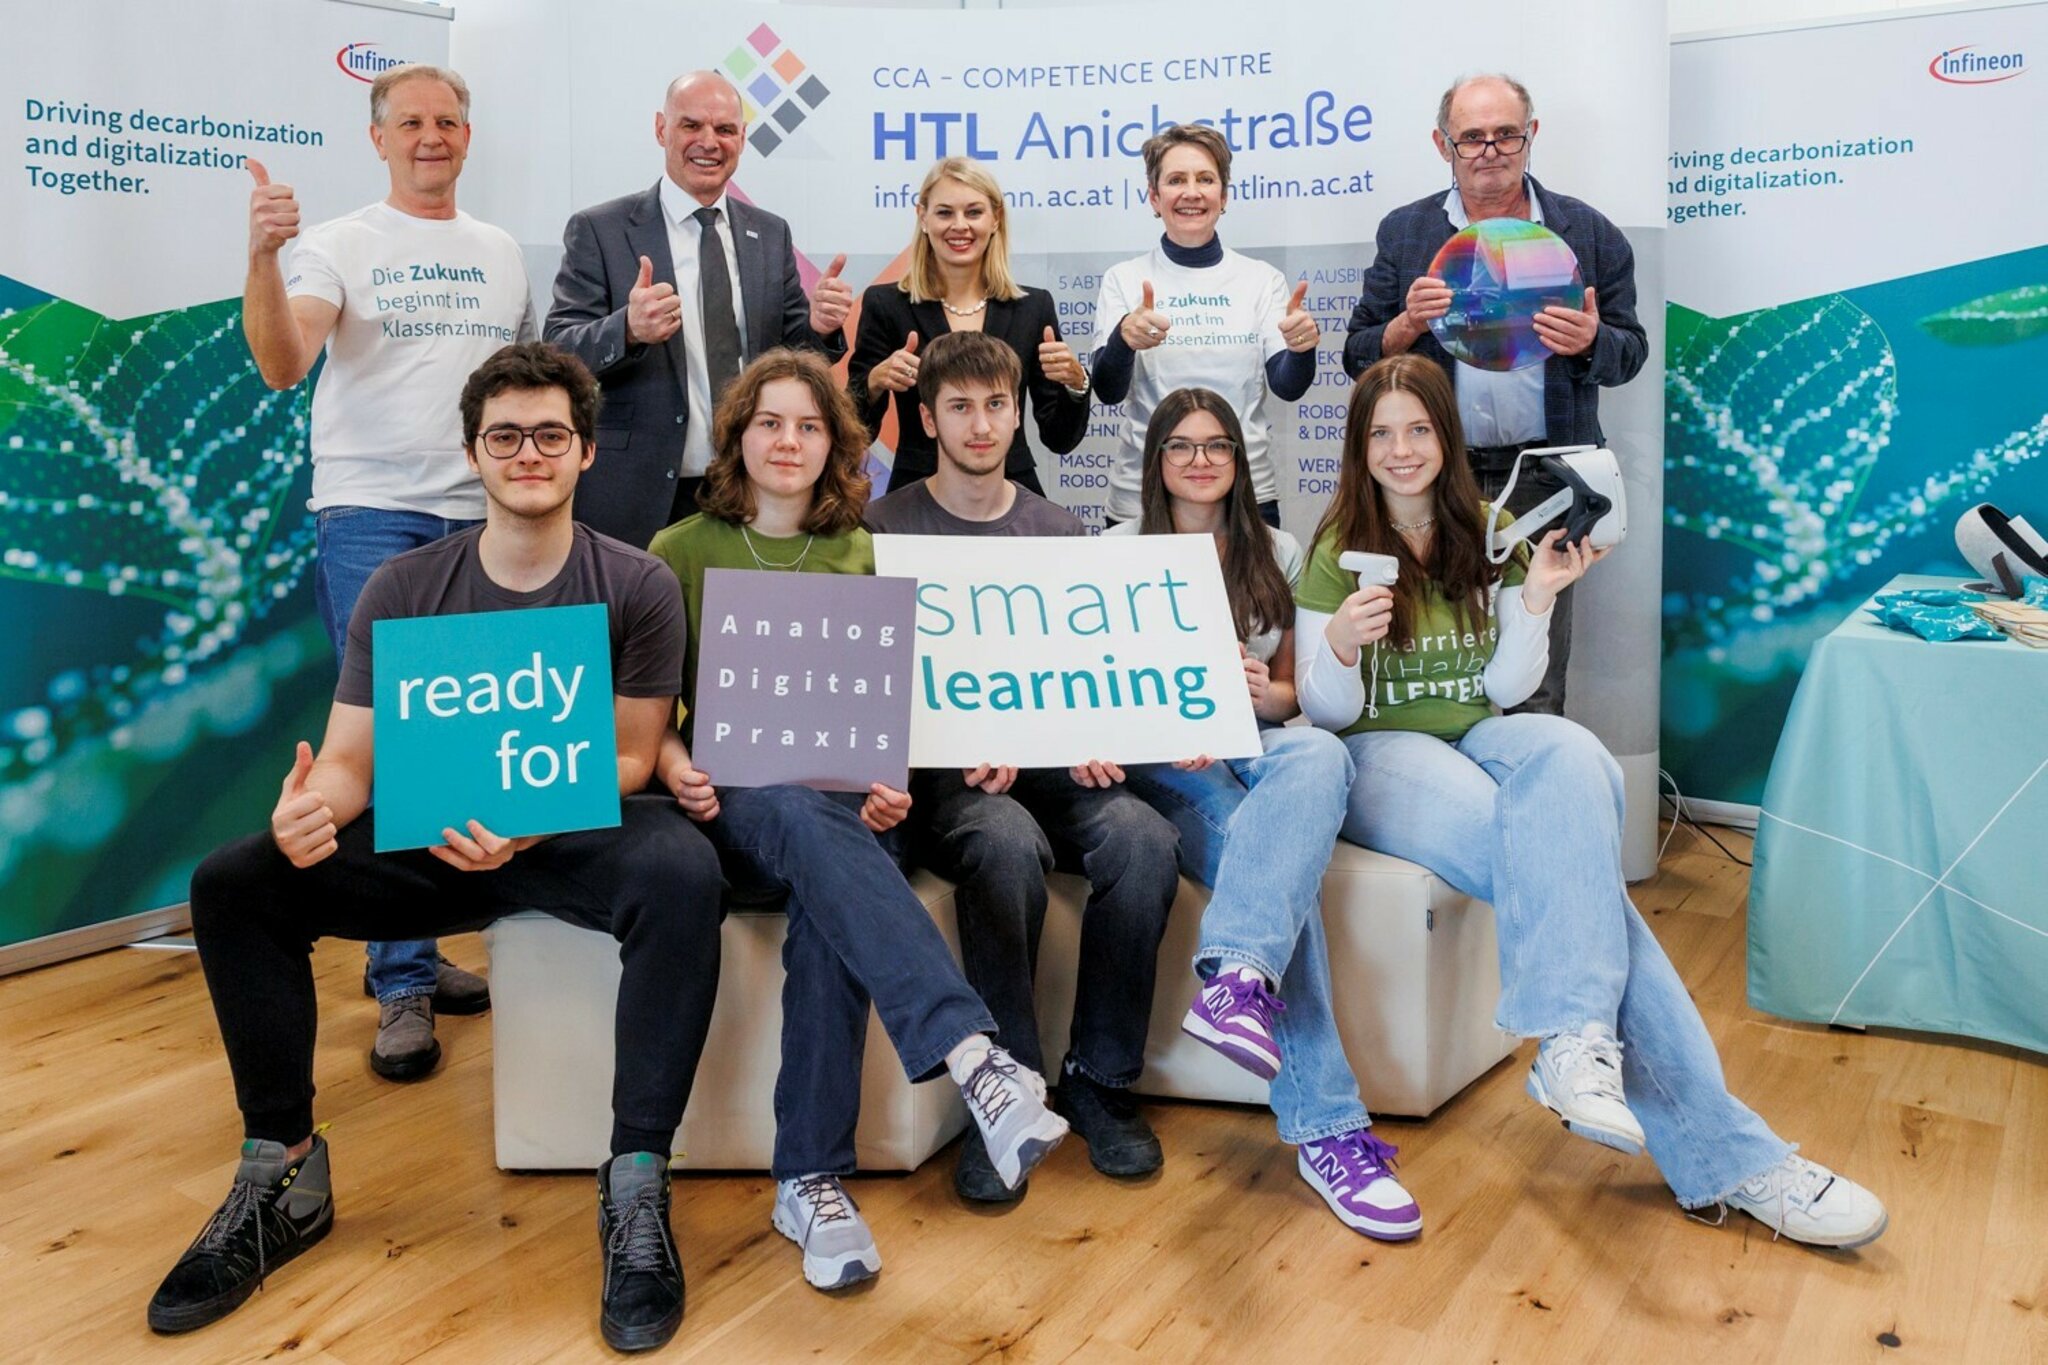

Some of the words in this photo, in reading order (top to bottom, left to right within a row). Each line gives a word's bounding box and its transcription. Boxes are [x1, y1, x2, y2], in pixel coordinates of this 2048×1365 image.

[348, 44, 416, 71] infine
[873, 67, 930, 88] CCA
[963, 62, 1153, 88] COMPETENCE
[1163, 52, 1272, 82] CENTRE
[1942, 51, 2023, 75] infineon
[26, 99, 123, 134] Driving
[129, 109, 324, 147] decarbonization
[873, 112, 999, 161] HTL
[25, 135, 78, 157] and
[1730, 136, 1914, 165] decarbonization
[26, 166, 150, 195] Together.
[1694, 168, 1844, 196] digitalization.
[372, 267, 405, 286] Die
[409, 262, 487, 284] Zukunft
[1059, 275, 1068, 290] 5
[1072, 275, 1103, 290] ABT
[376, 291, 451, 313] beginnt
[455, 292, 480, 309] im
[1169, 293, 1231, 308] Zukunft
[382, 319, 516, 342] Klassenzimmer
[1205, 313, 1224, 326] im
[1299, 424, 1310, 440] &
[1060, 474, 1109, 488] ROBO
[916, 568, 1200, 637] smart
[720, 614, 895, 647] Analog
[399, 651, 585, 724] ready
[718, 667, 893, 696] Digital
[921, 654, 1217, 721] learning
[715, 722, 889, 751] Praxis
[495, 730, 591, 791] for
